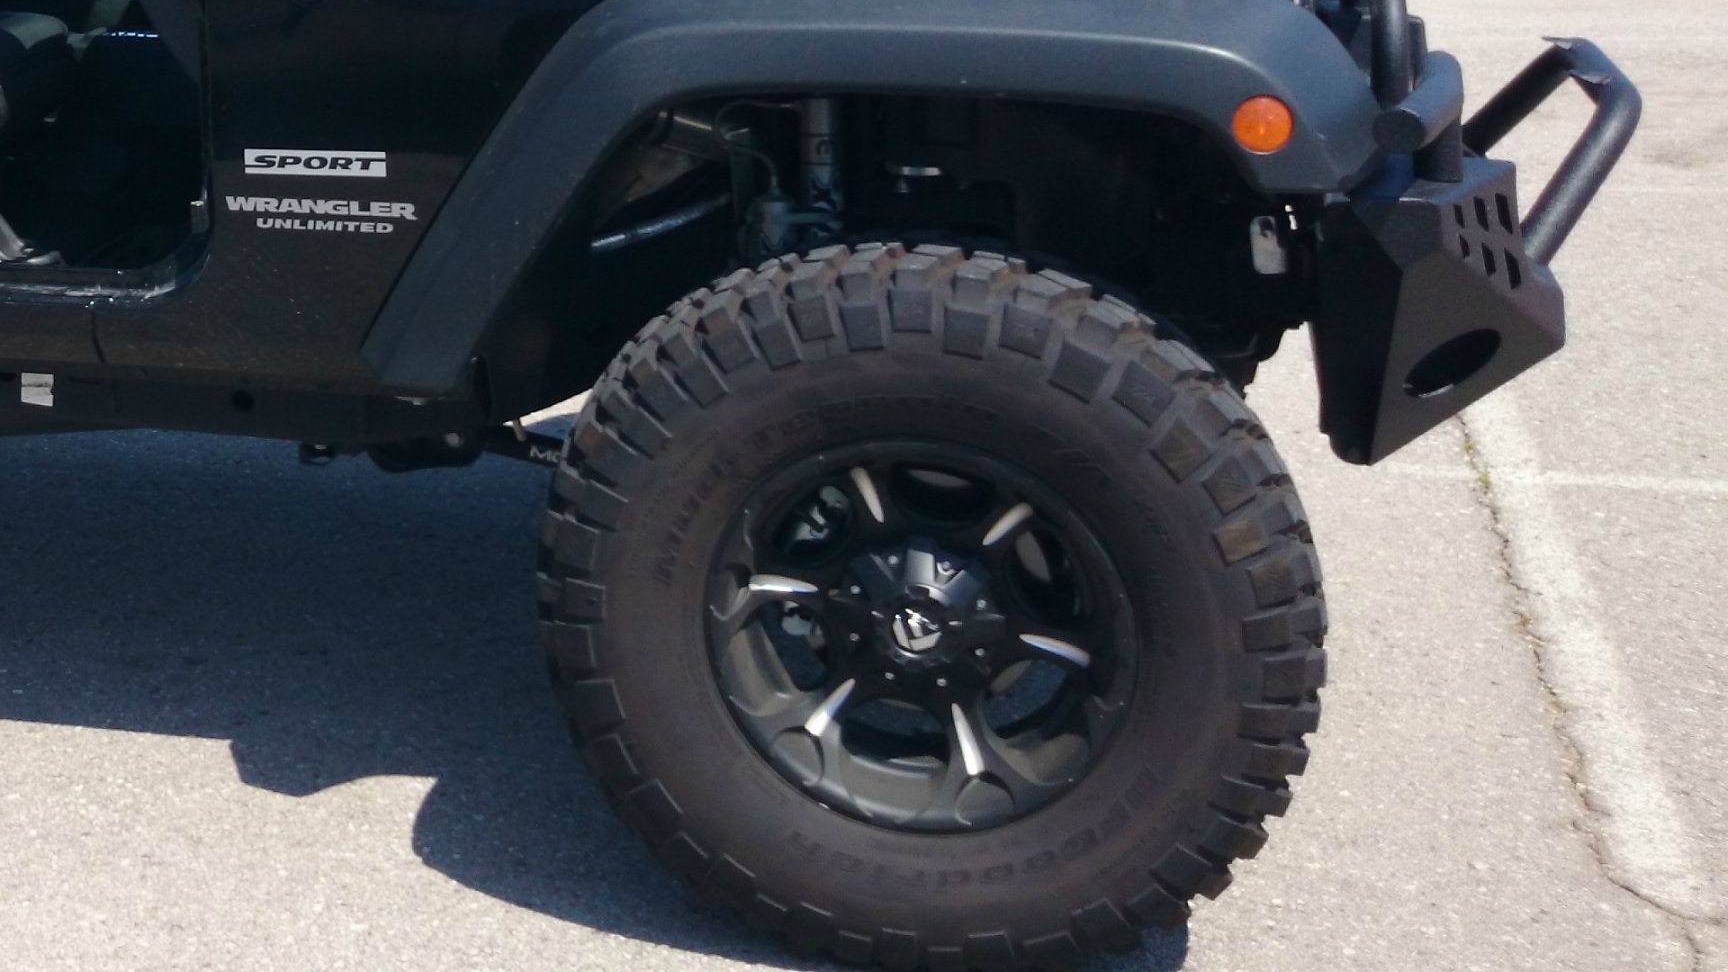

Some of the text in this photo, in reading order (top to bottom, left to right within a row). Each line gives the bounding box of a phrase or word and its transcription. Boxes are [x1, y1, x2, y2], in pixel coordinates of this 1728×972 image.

[252, 154, 380, 171] SPORT
[225, 195, 418, 220] WRANGLER
[256, 217, 394, 234] UNLIMITED
